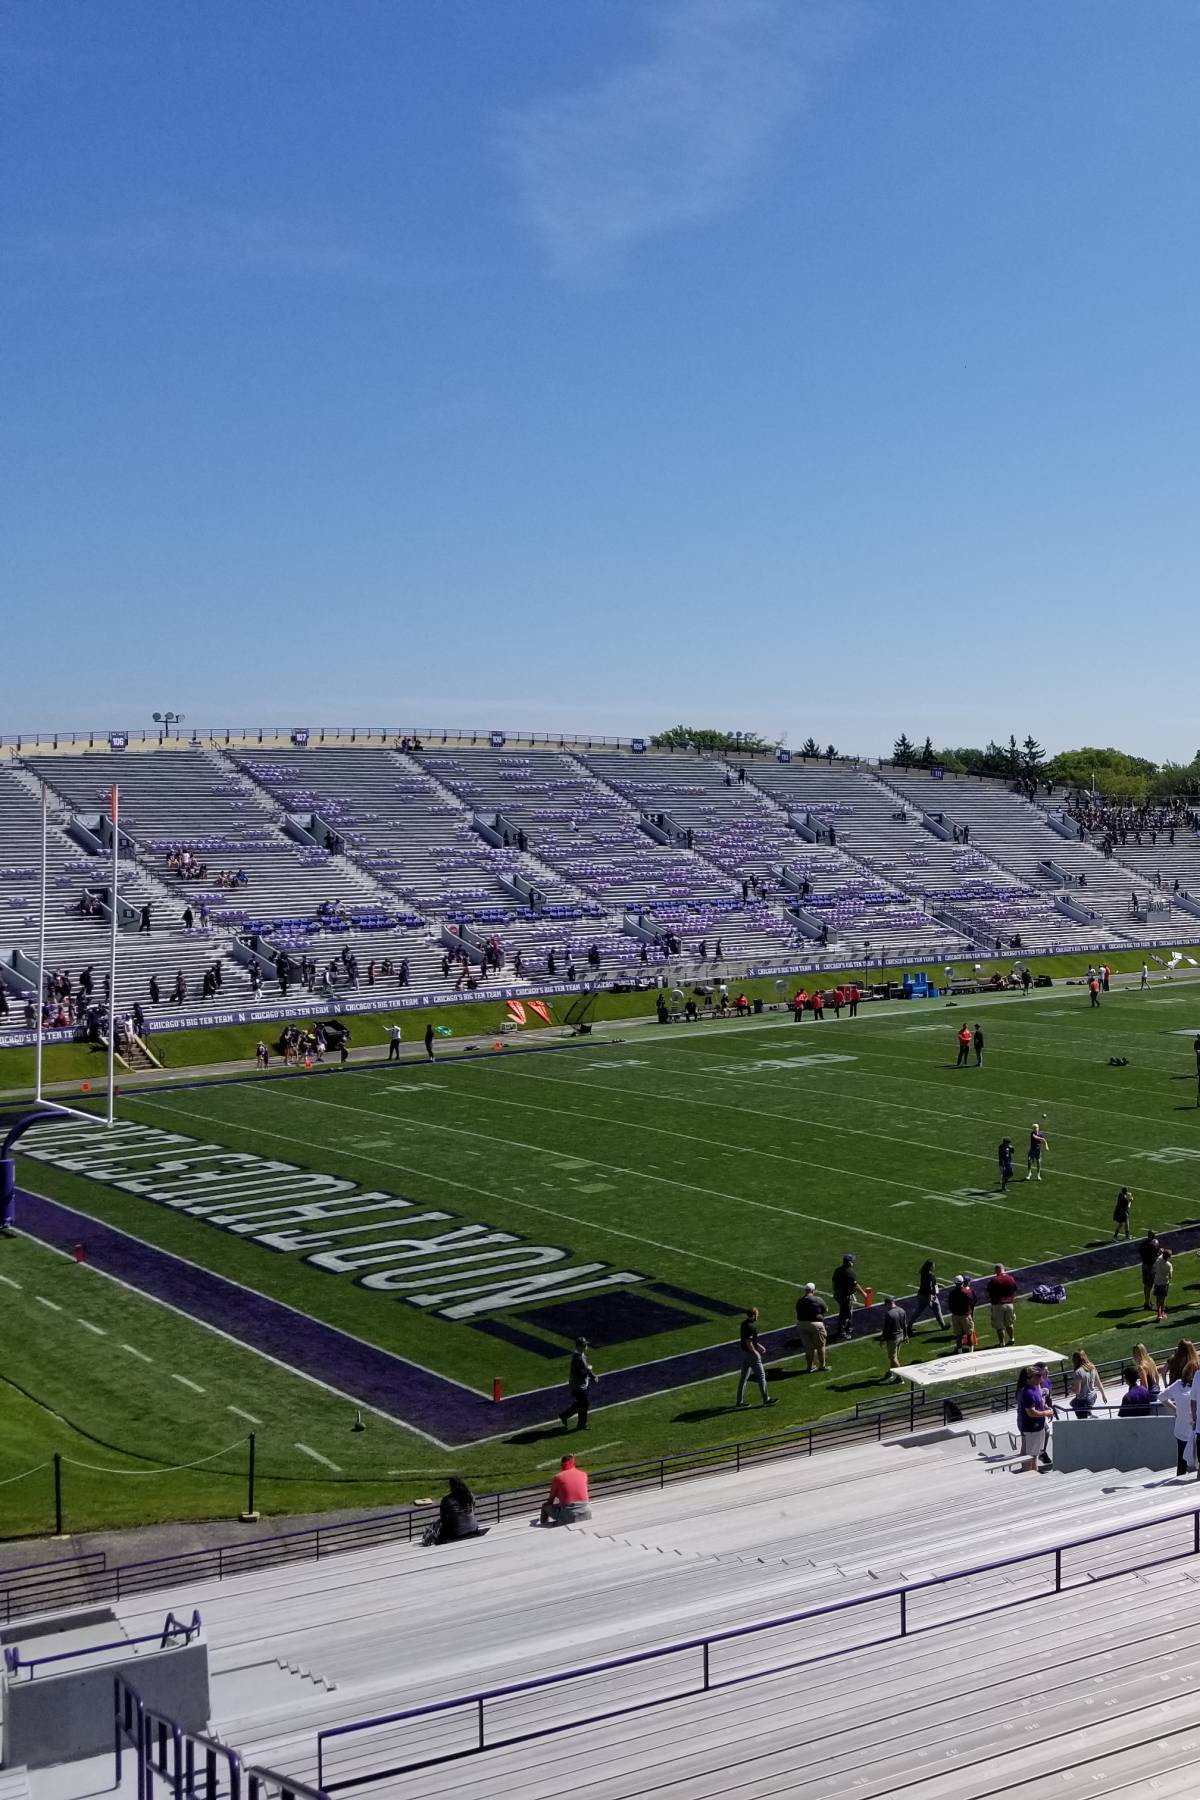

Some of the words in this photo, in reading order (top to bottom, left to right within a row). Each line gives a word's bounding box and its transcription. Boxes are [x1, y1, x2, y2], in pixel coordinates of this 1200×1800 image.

[113, 738, 124, 746] 106
[296, 734, 307, 742] 107
[516, 986, 543, 995] CHICAGO'S
[544, 985, 554, 993] BIG
[554, 984, 565, 992] TEN
[565, 983, 581, 991] TEAM
[584, 982, 590, 990] N
[433, 993, 463, 1003] CHICAGO'S
[506, 989, 512, 997] N
[345, 1001, 376, 1011] CHICAGO'S
[377, 1000, 388, 1008] BIG
[389, 999, 401, 1007] TEN
[401, 997, 418, 1005] TEAM
[423, 996, 429, 1005] N
[251, 1009, 285, 1020] CHICAGO'S
[285, 1008, 296, 1016] BIG
[297, 1007, 310, 1015] TEN
[312, 1006, 329, 1014] TEAM
[334, 1005, 341, 1013] N
[149, 1018, 185, 1030] CHICAGO'S
[186, 1018, 198, 1027] BIG
[200, 1017, 214, 1025] TEN
[214, 1015, 233, 1023] TEAM
[239, 1013, 245, 1022] N
